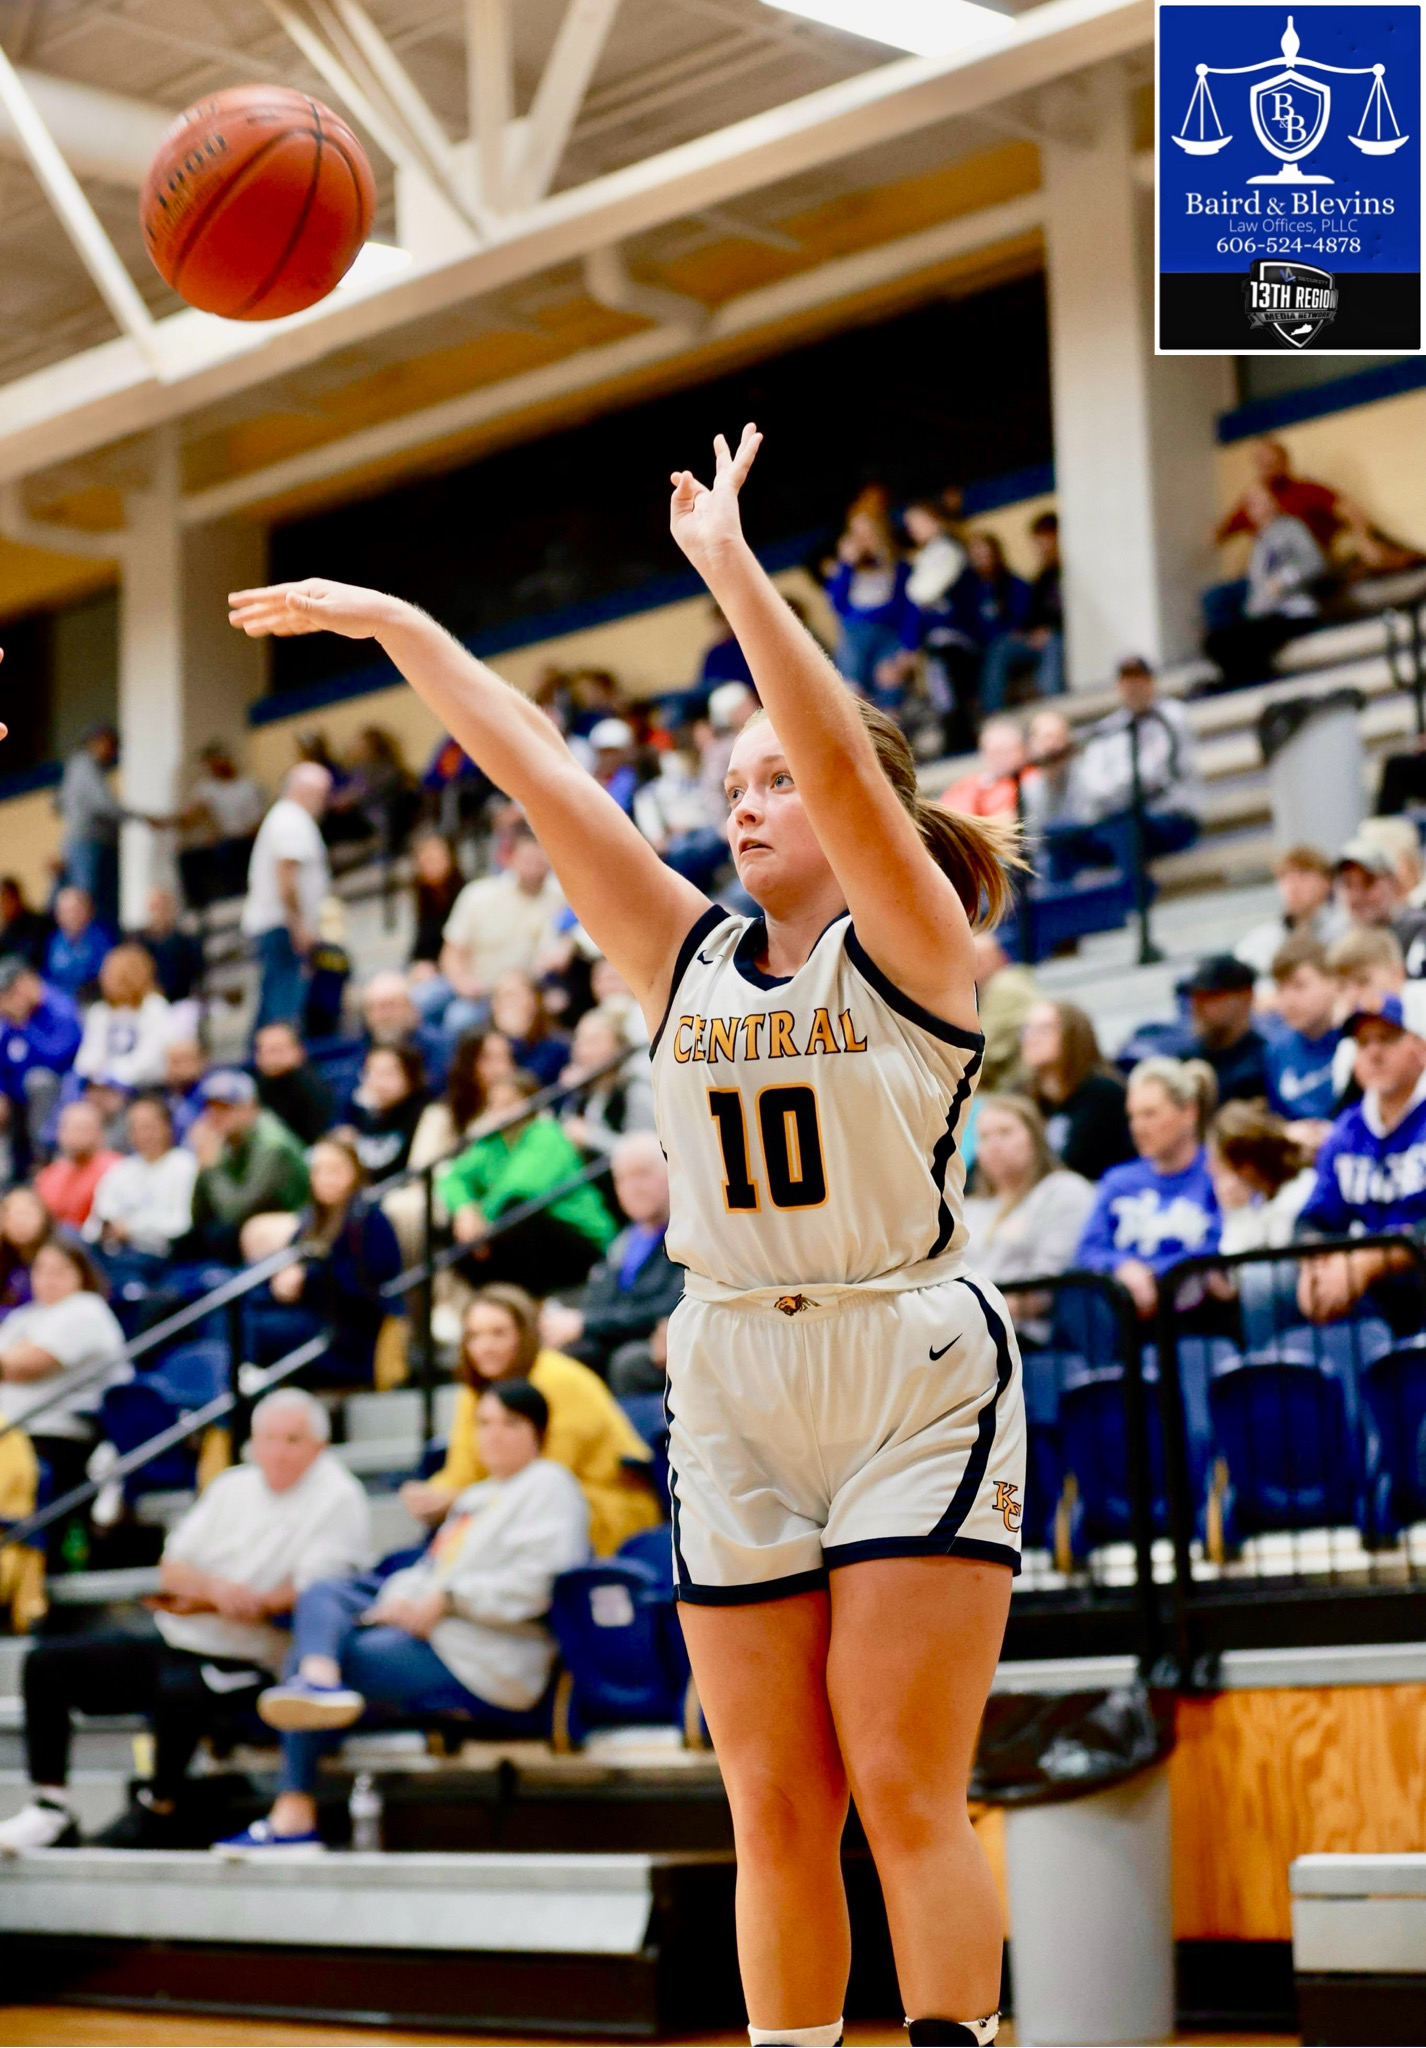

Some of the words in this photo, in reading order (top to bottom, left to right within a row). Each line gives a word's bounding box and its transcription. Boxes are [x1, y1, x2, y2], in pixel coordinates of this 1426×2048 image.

[673, 1007, 868, 1064] CENTRAL
[705, 1081, 830, 1214] 10
[992, 1480, 1022, 1533] KC
